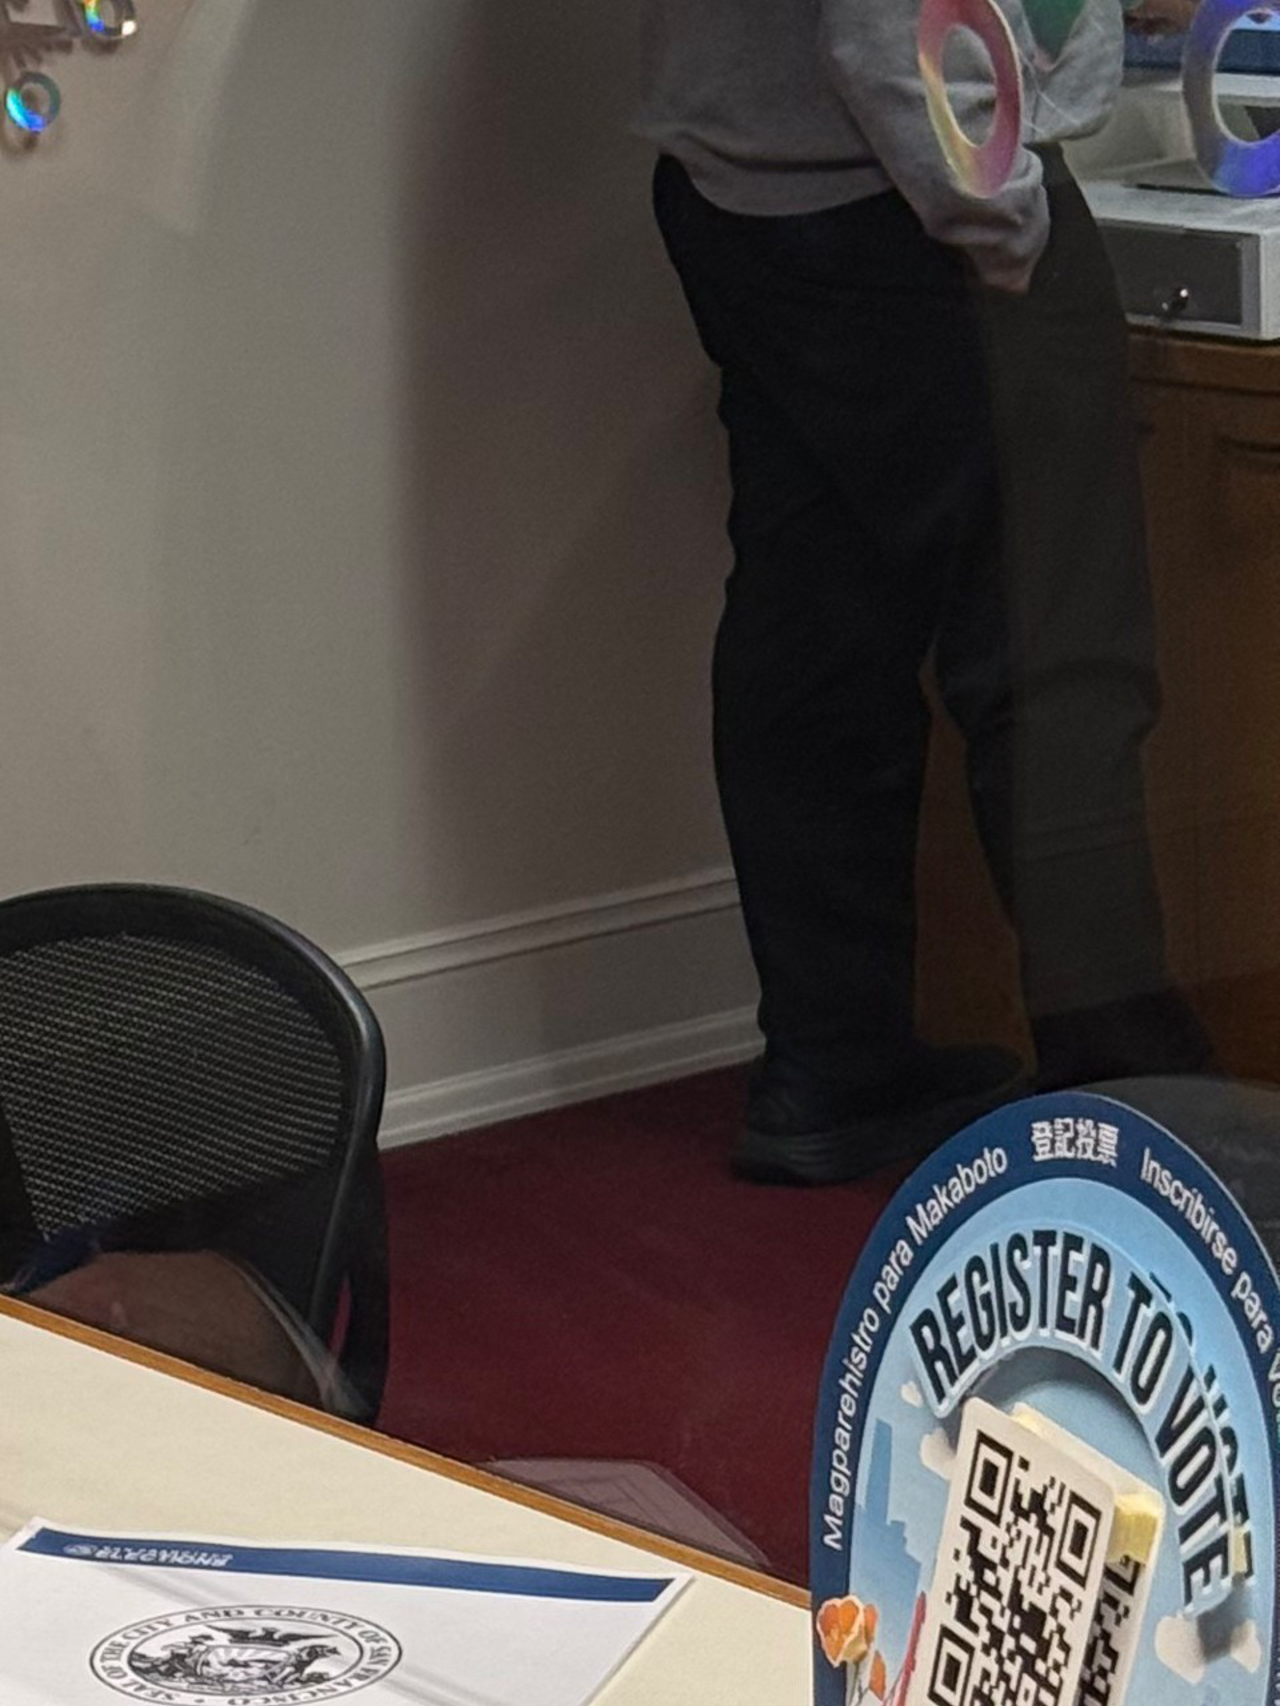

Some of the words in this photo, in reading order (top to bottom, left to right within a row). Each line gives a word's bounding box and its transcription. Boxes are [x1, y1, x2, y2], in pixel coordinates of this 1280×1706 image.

[1030, 1116, 1120, 1169] 登記投票
[1140, 1146, 1239, 1276] Inscribirse
[1230, 1270, 1275, 1355] para
[822, 1307, 880, 1552] Magparehistro
[872, 1238, 915, 1315] para
[904, 1146, 1009, 1246] Makaboto
[908, 1229, 1113, 1406] REGISTER
[1111, 1270, 1177, 1407] TO
[1154, 1363, 1234, 1611] VOTE
[184, 1609, 245, 1623] AND
[253, 1608, 366, 1631] COUNTY
[121, 1618, 174, 1641] CITY
[357, 1629, 390, 1645] OF
[100, 1640, 131, 1664] THE
[367, 1645, 392, 1667] SAN
[100, 1664, 129, 1680] OF
[121, 1679, 182, 1701] SEAL
[227, 1665, 381, 1706] FRANCISCO
